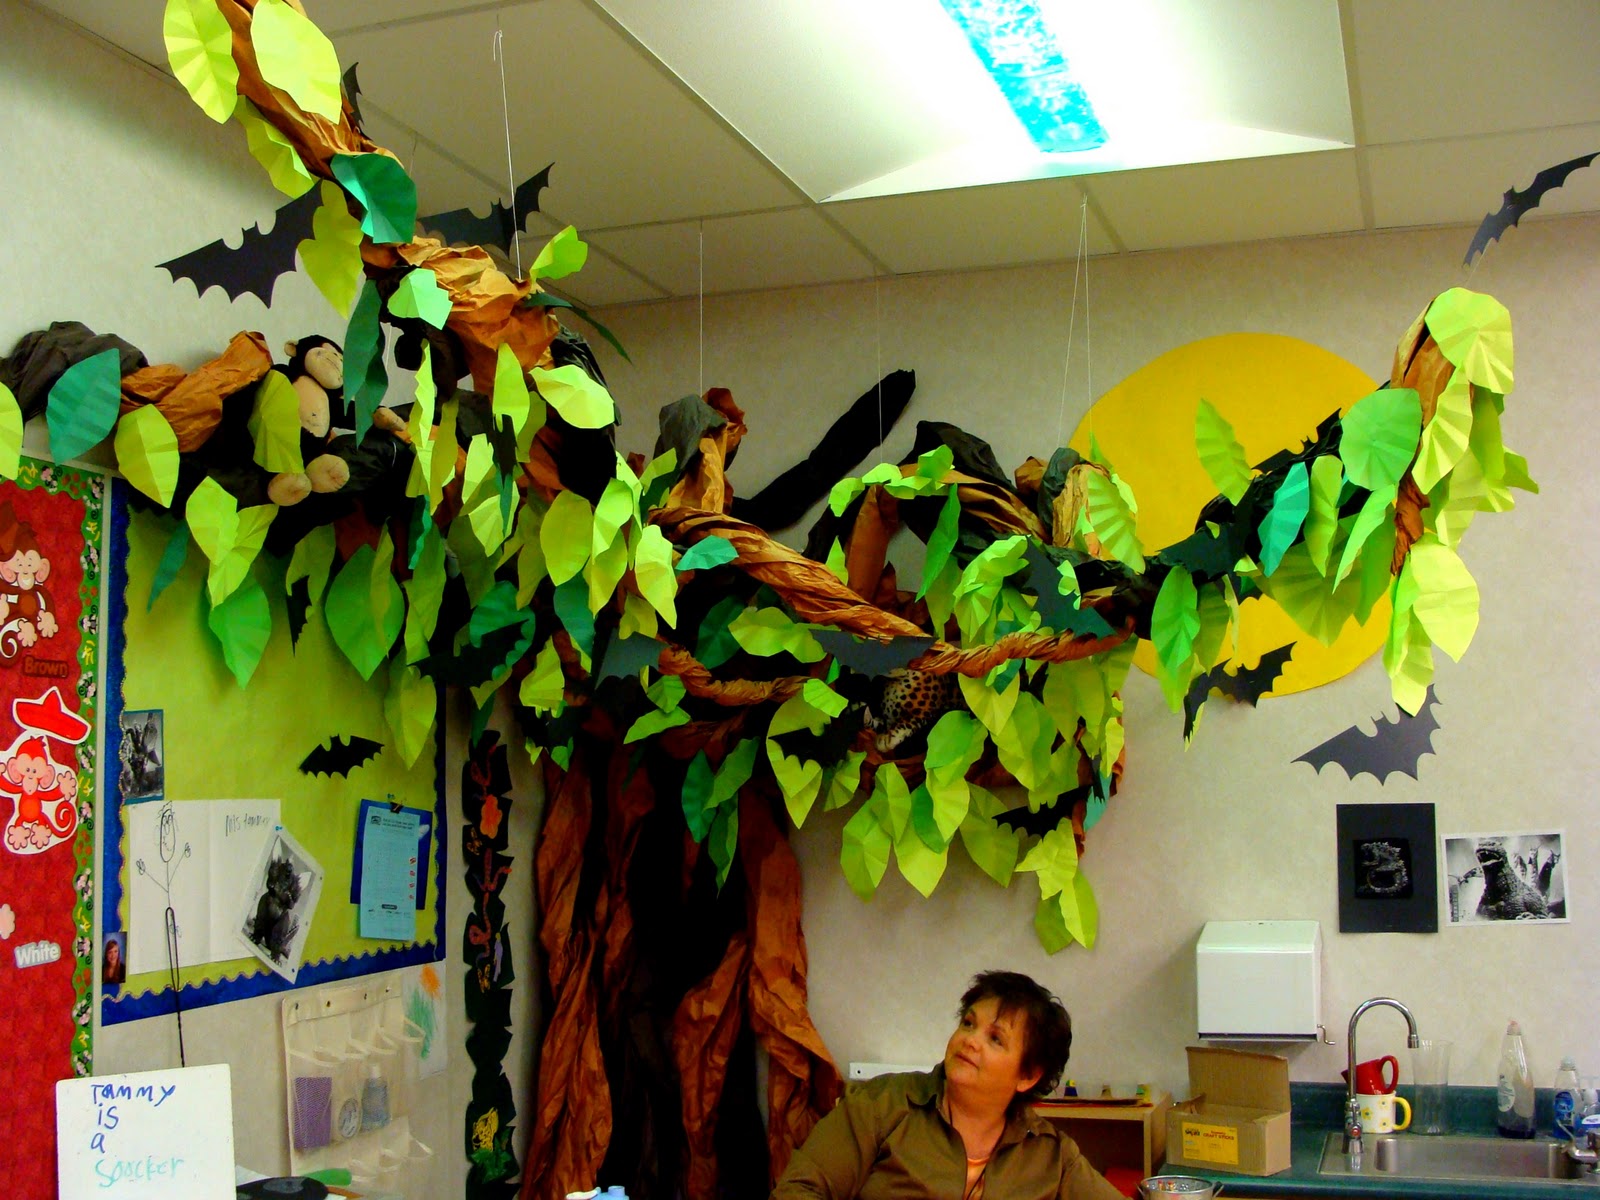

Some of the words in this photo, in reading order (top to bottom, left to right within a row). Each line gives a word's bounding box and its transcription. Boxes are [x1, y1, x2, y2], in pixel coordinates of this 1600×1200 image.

[24, 656, 68, 676] Brown
[15, 942, 60, 966] White
[90, 1132, 106, 1154] a
